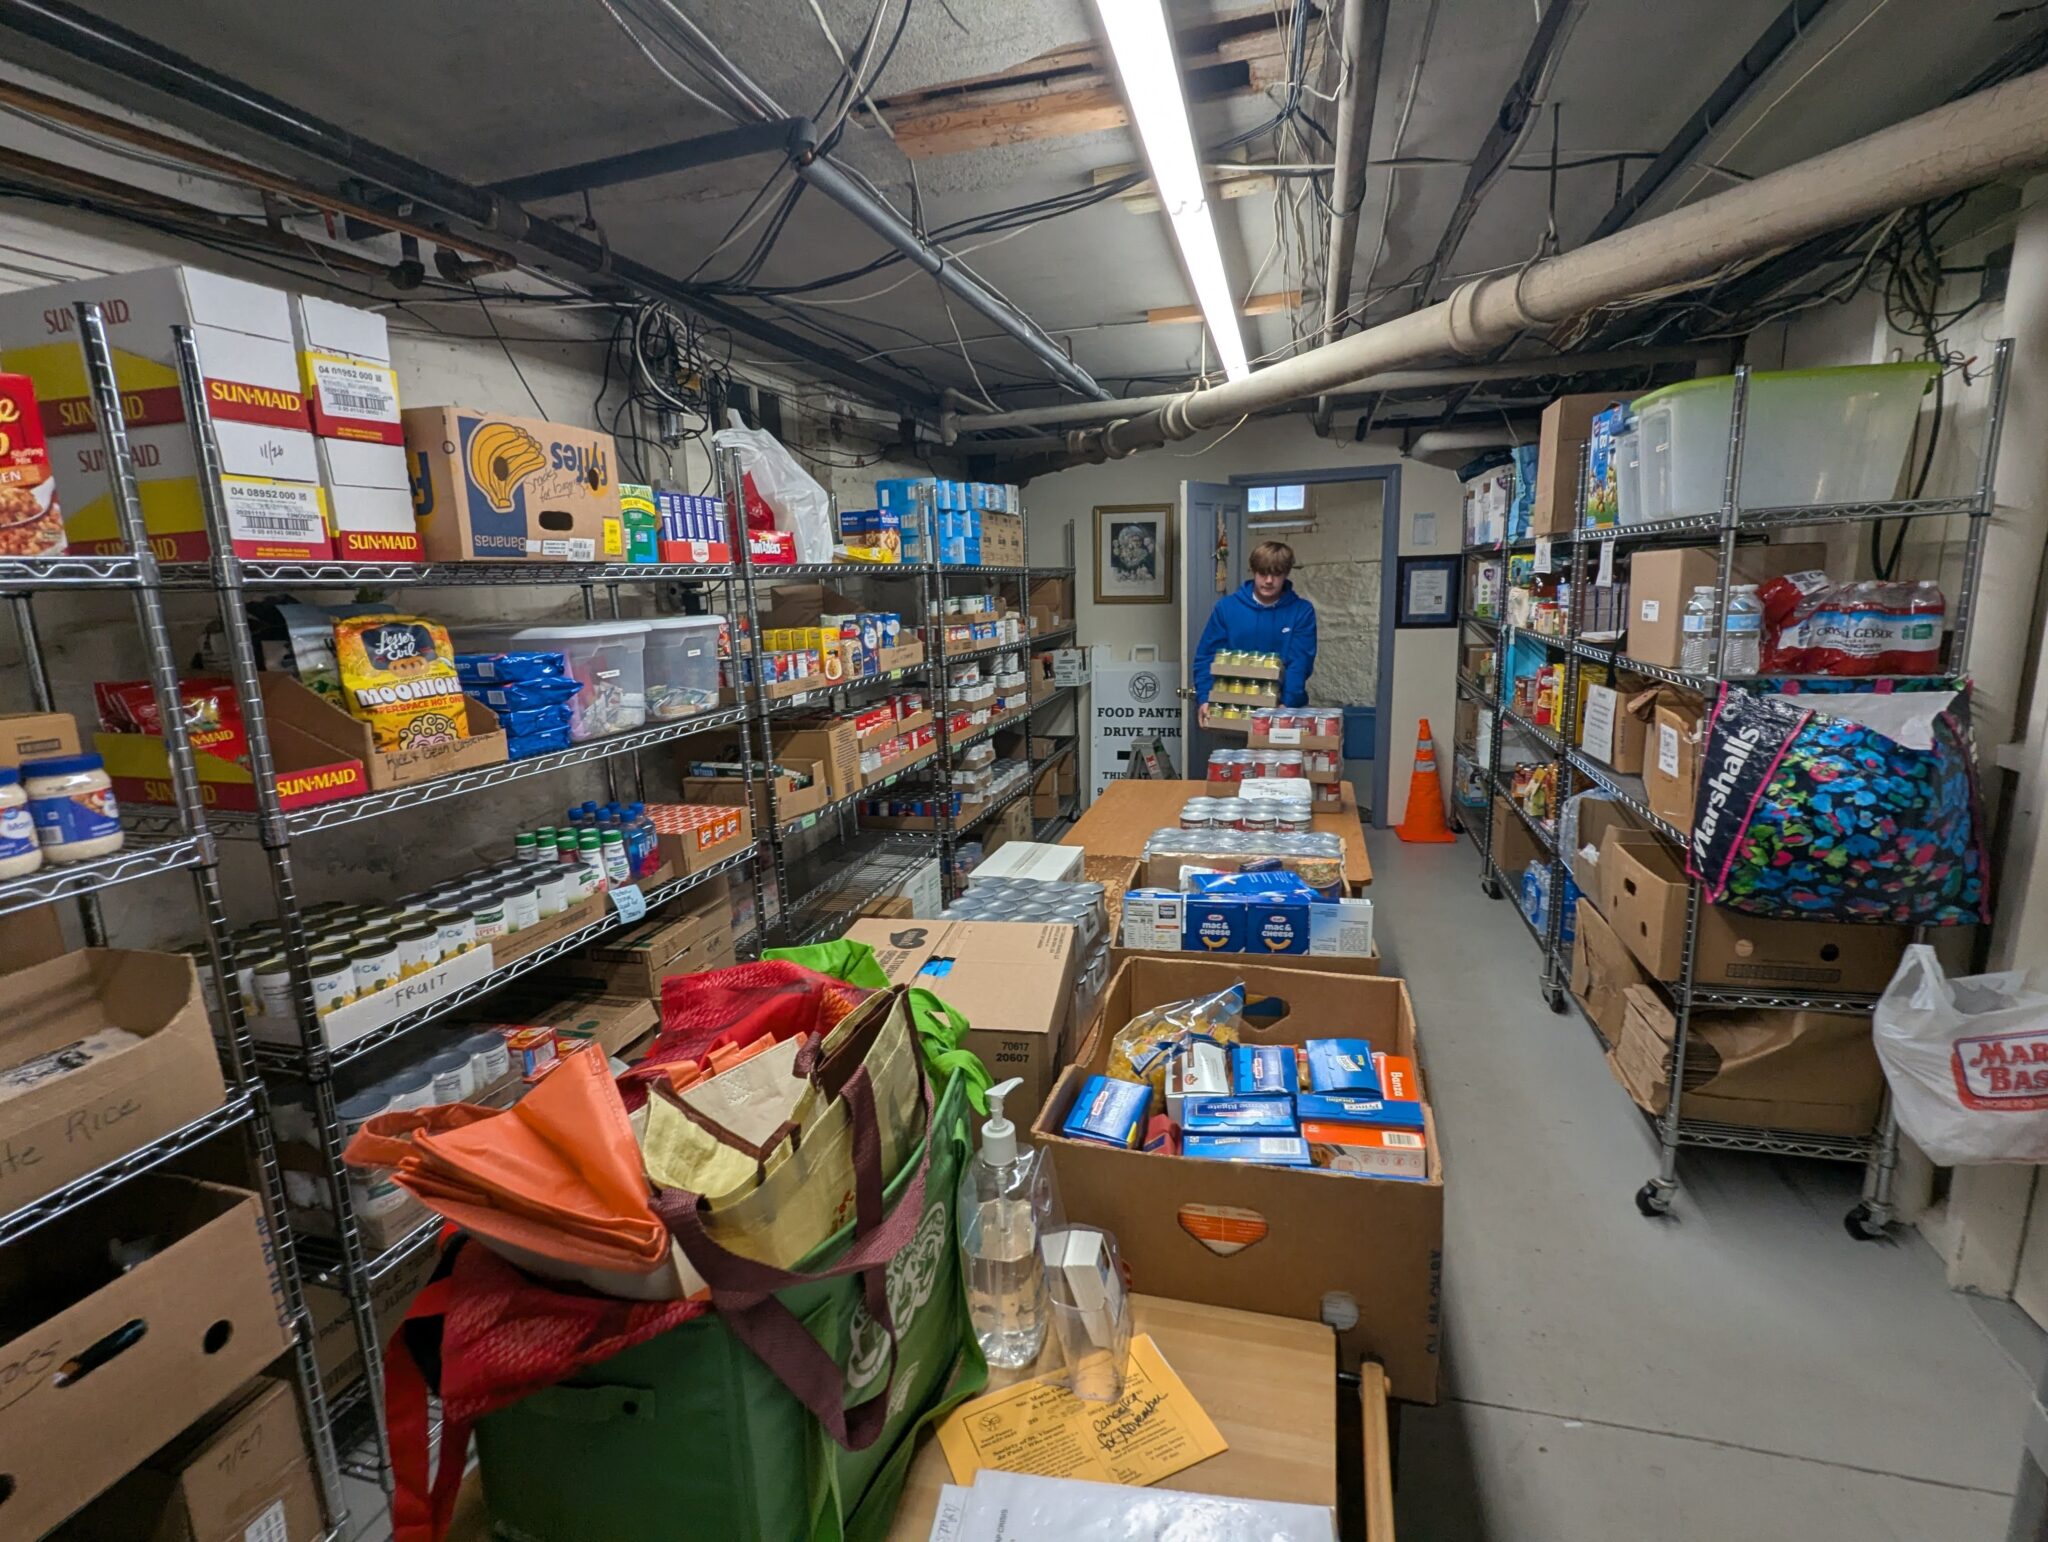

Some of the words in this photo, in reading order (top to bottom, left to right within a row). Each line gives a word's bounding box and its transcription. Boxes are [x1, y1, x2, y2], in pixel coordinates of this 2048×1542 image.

[231, 487, 244, 496] 04
[247, 489, 278, 499] 08952
[279, 491, 296, 500] 000
[474, 534, 526, 552] Bananas
[1097, 707, 1135, 718] FOOD
[1103, 727, 1144, 737] DRIVE
[1222, 921, 1229, 930] &
[1264, 923, 1284, 931] mac
[1284, 923, 1292, 931] &
[395, 972, 448, 1008] FRUIT
[1001, 1041, 1030, 1051] 70617
[996, 1053, 1030, 1063] 20607
[1391, 1071, 1404, 1098] Banza
[1119, 1392, 1169, 1444] November
